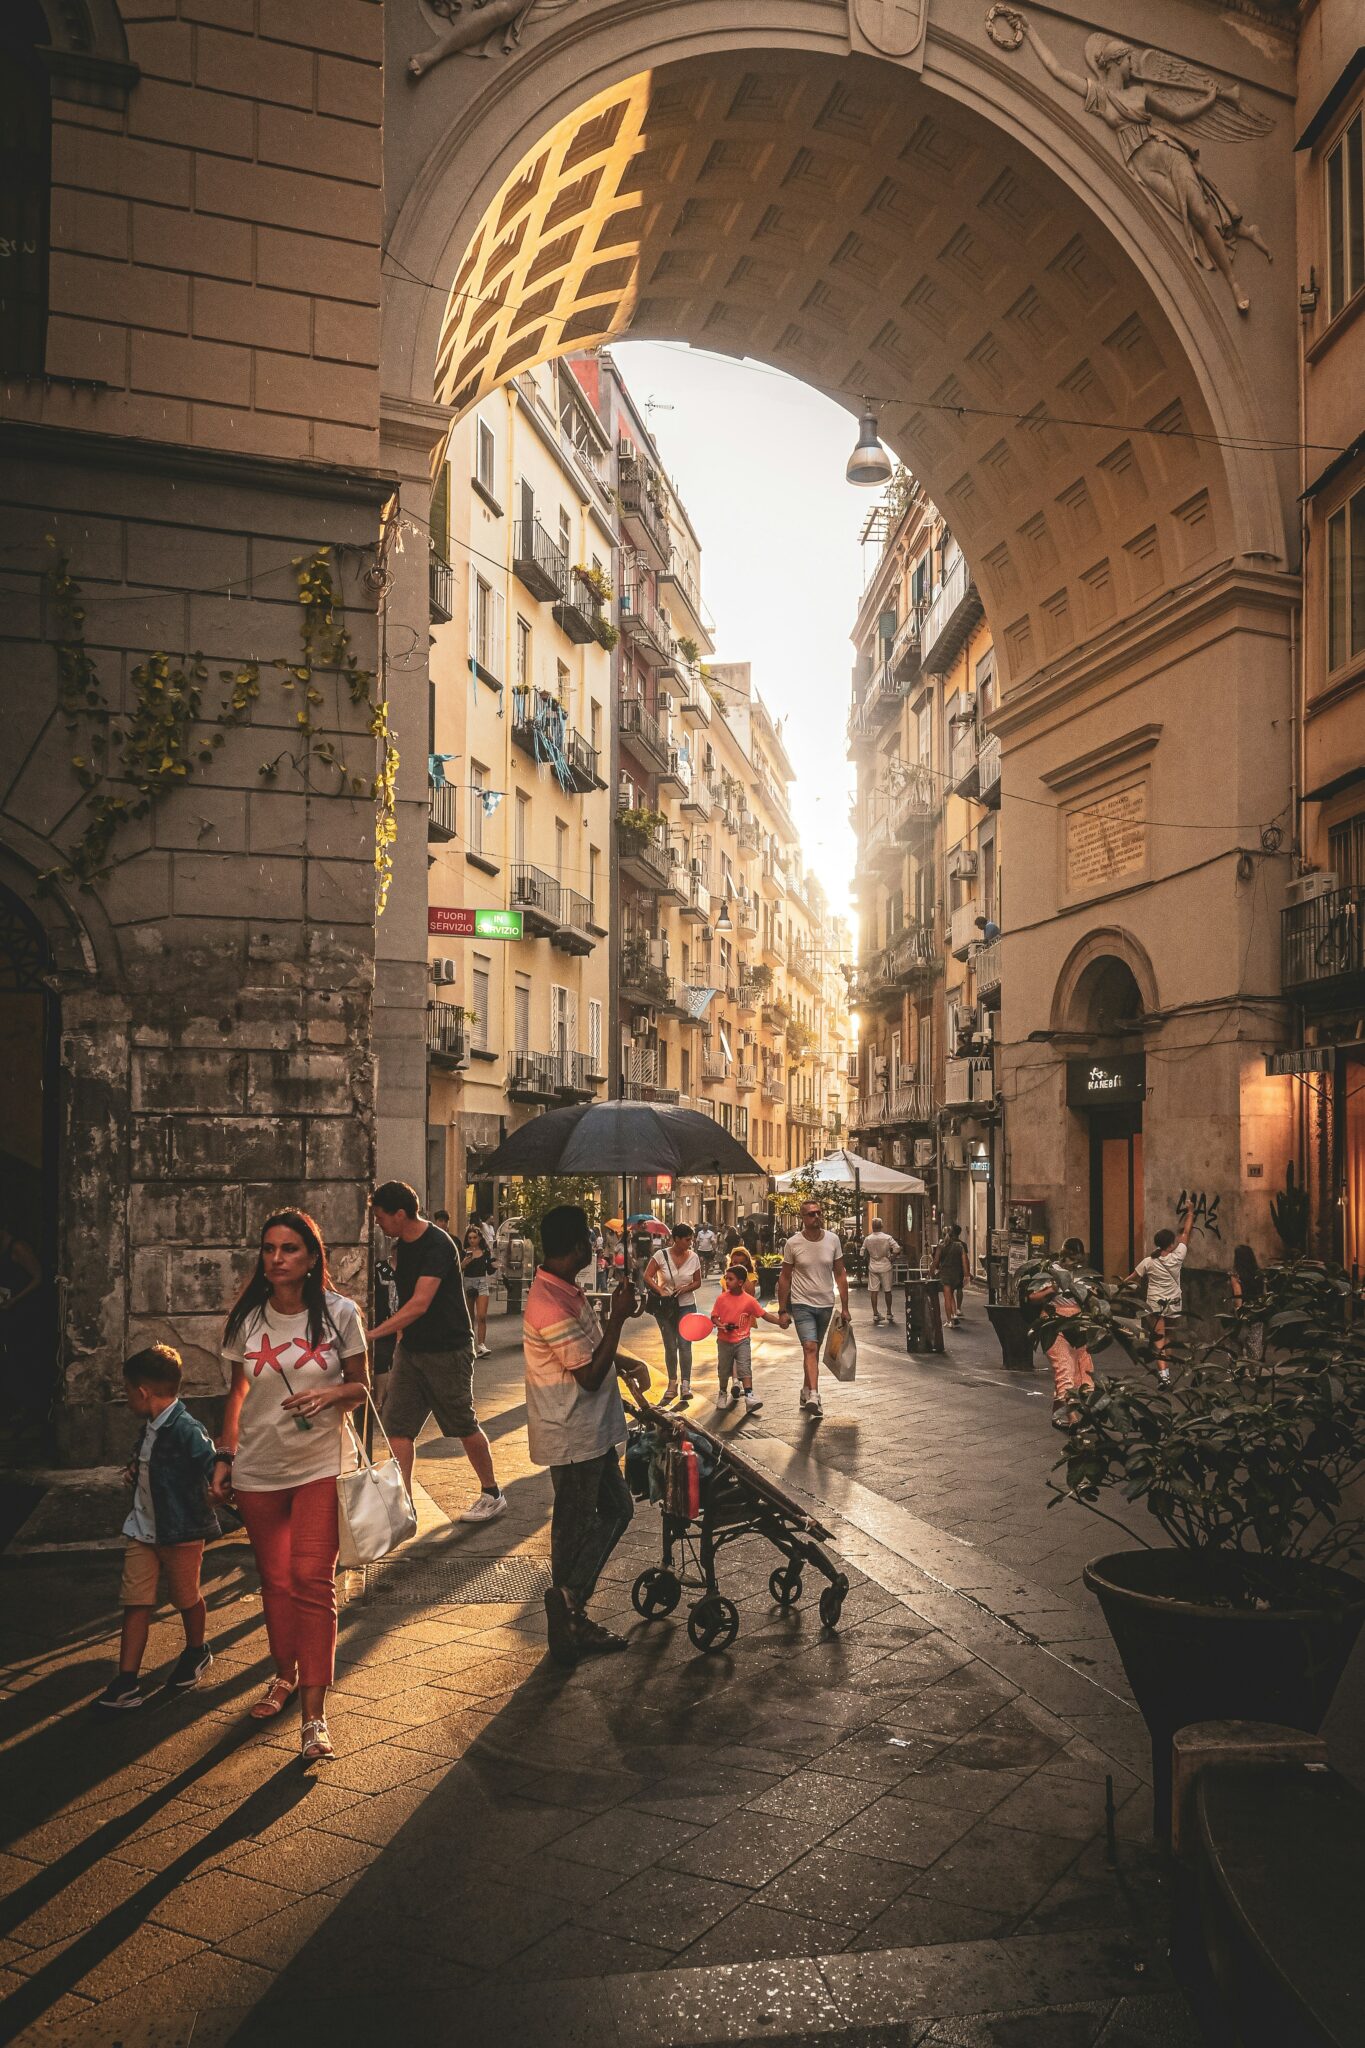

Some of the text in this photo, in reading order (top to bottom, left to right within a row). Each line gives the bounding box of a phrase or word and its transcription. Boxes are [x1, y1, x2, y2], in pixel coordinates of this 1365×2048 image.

[437, 911, 466, 921] FUORI
[493, 915, 503, 923] IN
[429, 921, 473, 932] SERVIZIO
